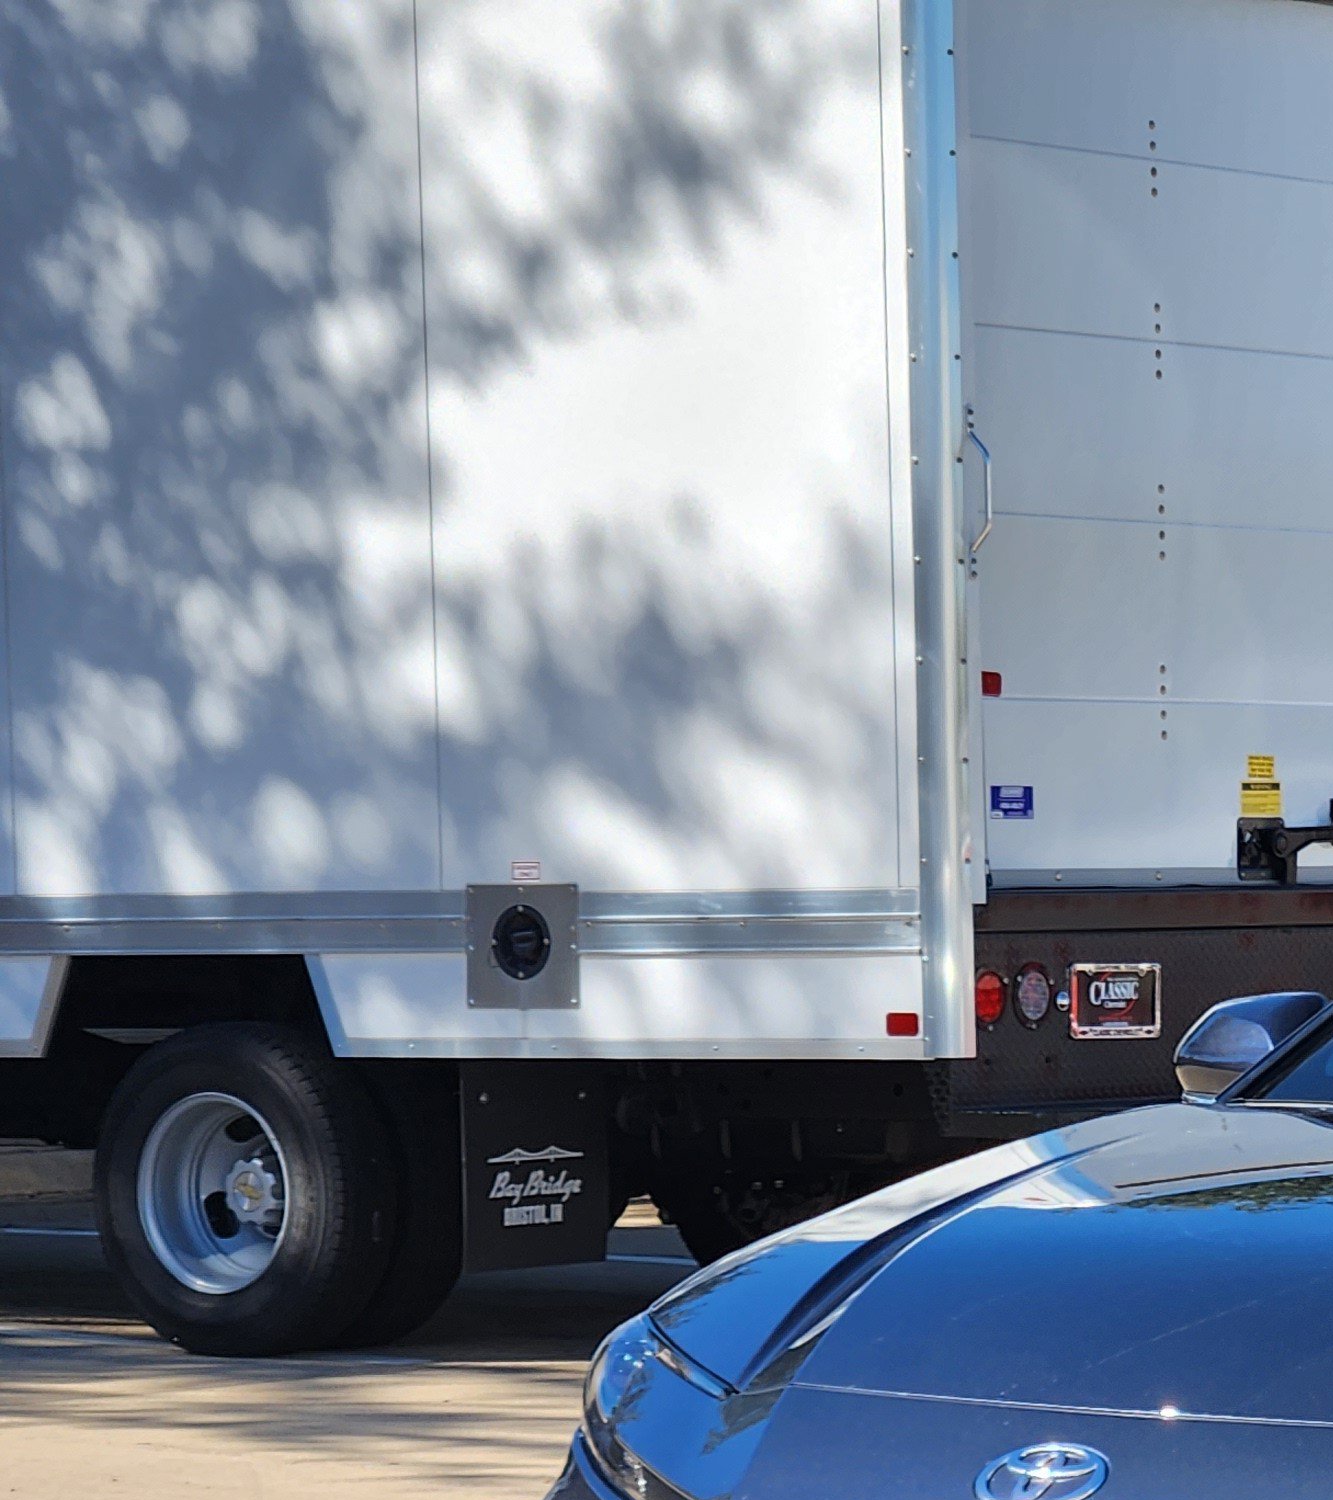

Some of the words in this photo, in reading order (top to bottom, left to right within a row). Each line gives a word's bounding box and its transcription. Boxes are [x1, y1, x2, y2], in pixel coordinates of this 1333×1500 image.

[1089, 980, 1140, 1006] CLASSIC
[488, 1170, 524, 1206] Bay
[522, 1169, 582, 1202] Bridge
